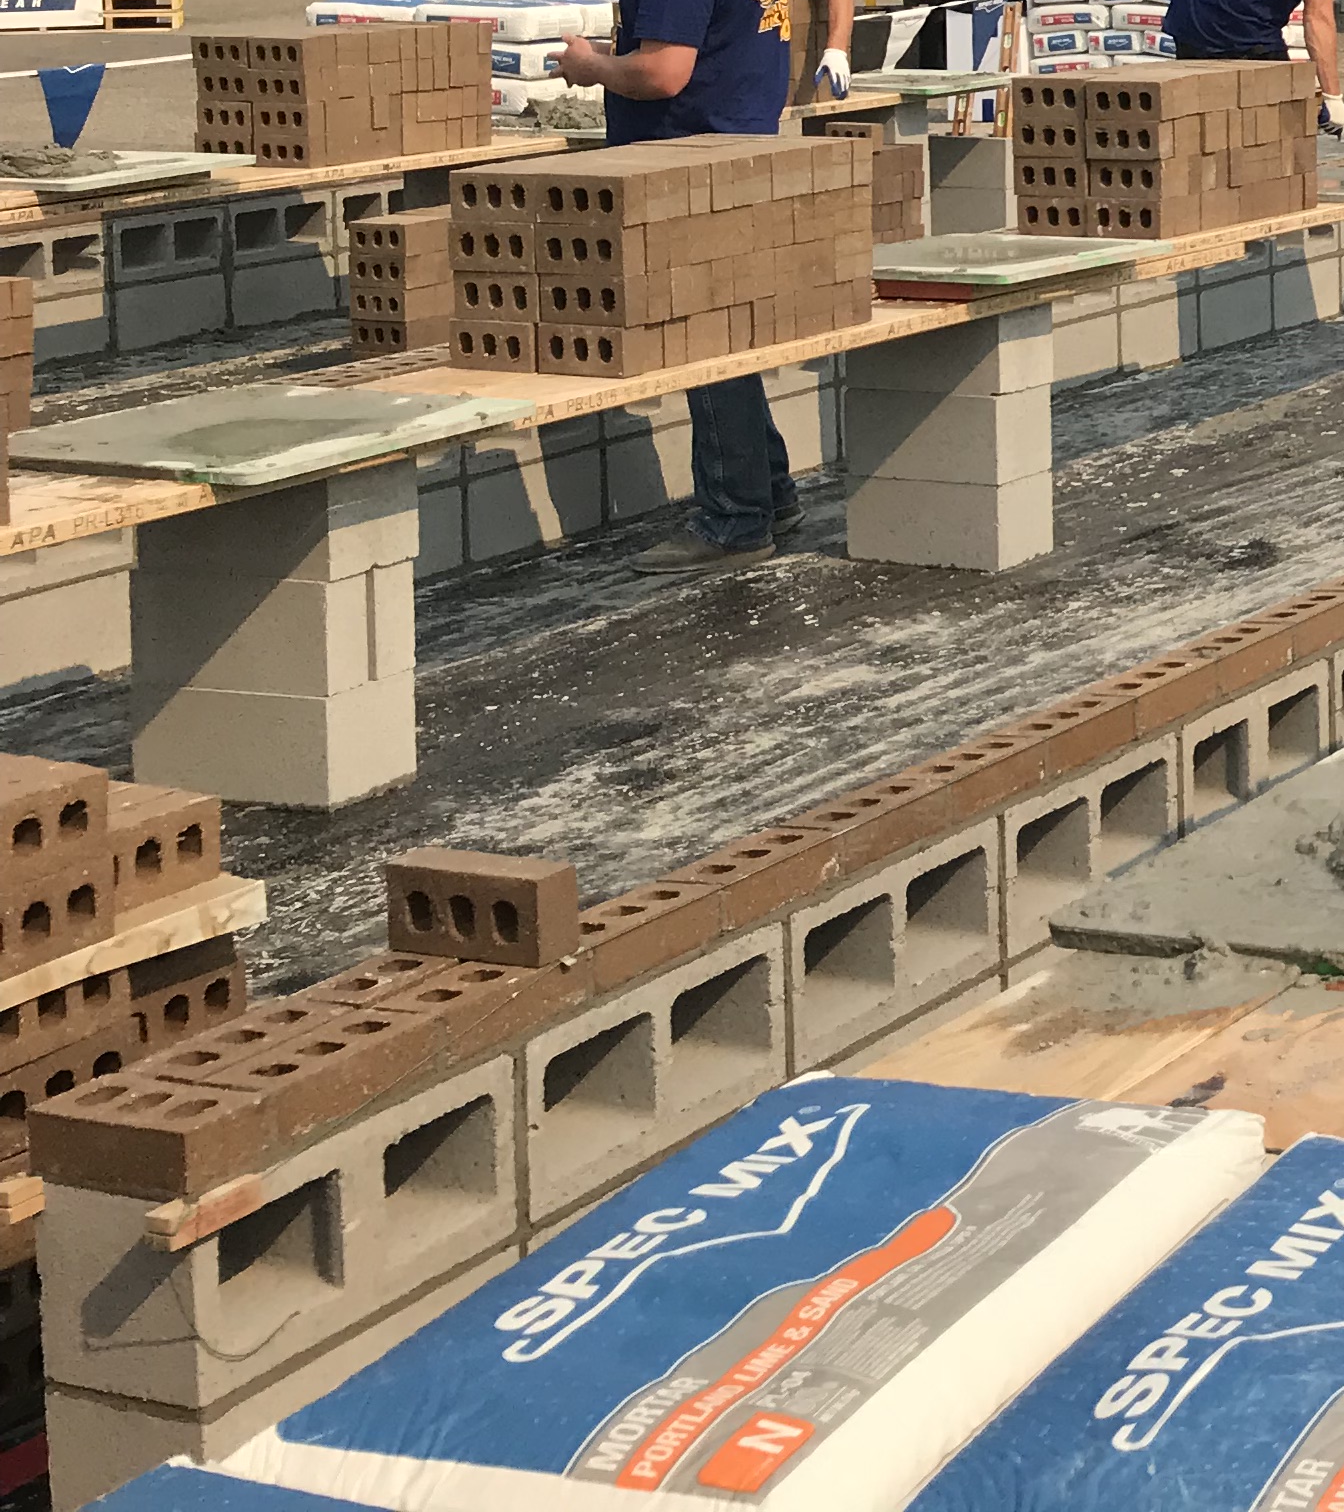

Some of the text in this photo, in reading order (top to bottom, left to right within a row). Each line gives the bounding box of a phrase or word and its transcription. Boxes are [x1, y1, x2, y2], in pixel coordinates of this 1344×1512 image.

[10, 522, 56, 550] APA
[493, 1115, 837, 1336] SPEC MIX
[631, 1384, 746, 1479] PORTLAND
[733, 1342, 796, 1383] LIME
[783, 1325, 814, 1343] &
[799, 1277, 860, 1321] SAND
[1093, 1284, 1273, 1420] SPEC
[584, 1376, 709, 1472] MORTAR
[737, 1419, 804, 1455] N
[1269, 1458, 1336, 1512] TAR
